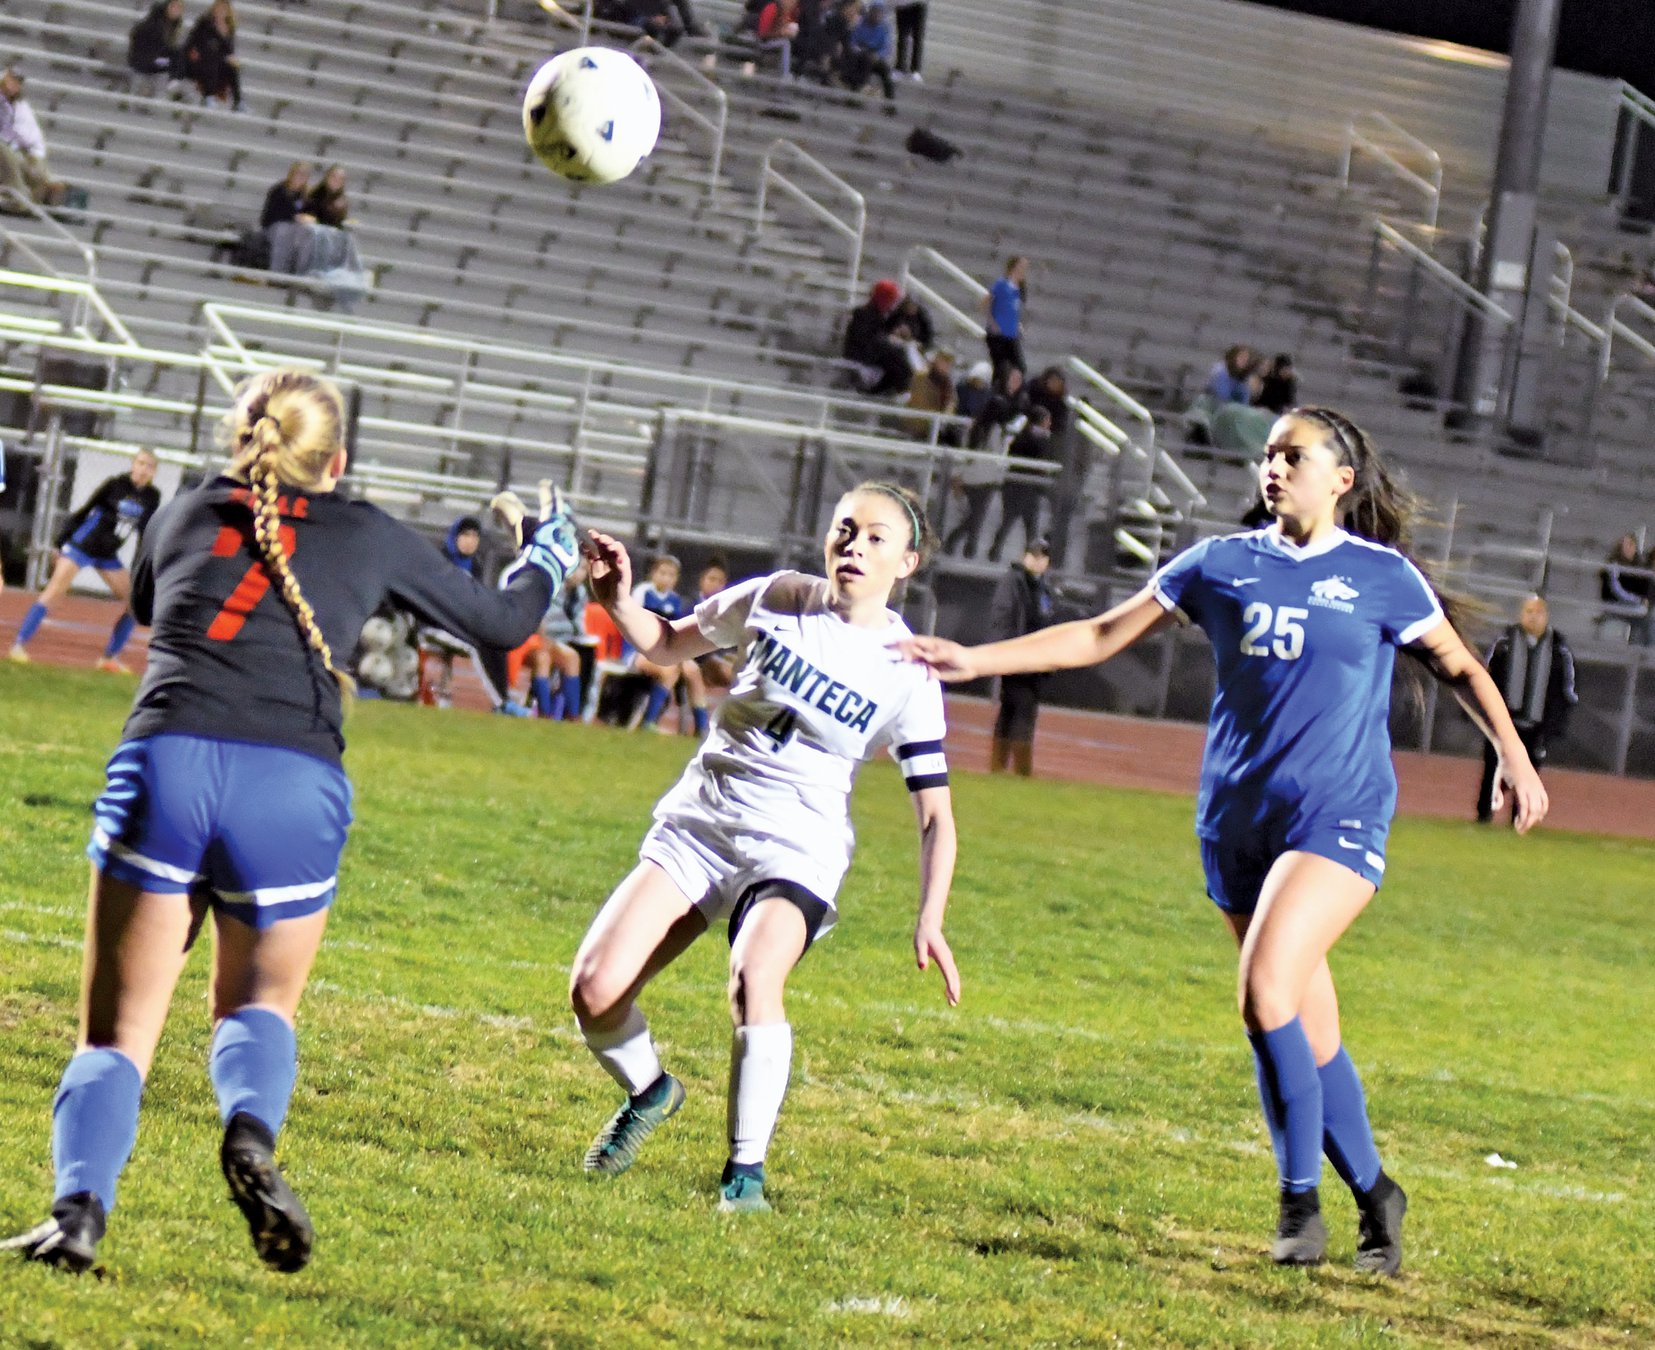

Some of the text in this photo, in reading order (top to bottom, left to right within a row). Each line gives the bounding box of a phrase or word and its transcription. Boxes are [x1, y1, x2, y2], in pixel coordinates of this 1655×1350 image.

[1240, 602, 1309, 661] 25
[747, 629, 878, 735] MANTECA
[764, 707, 797, 753] 4
